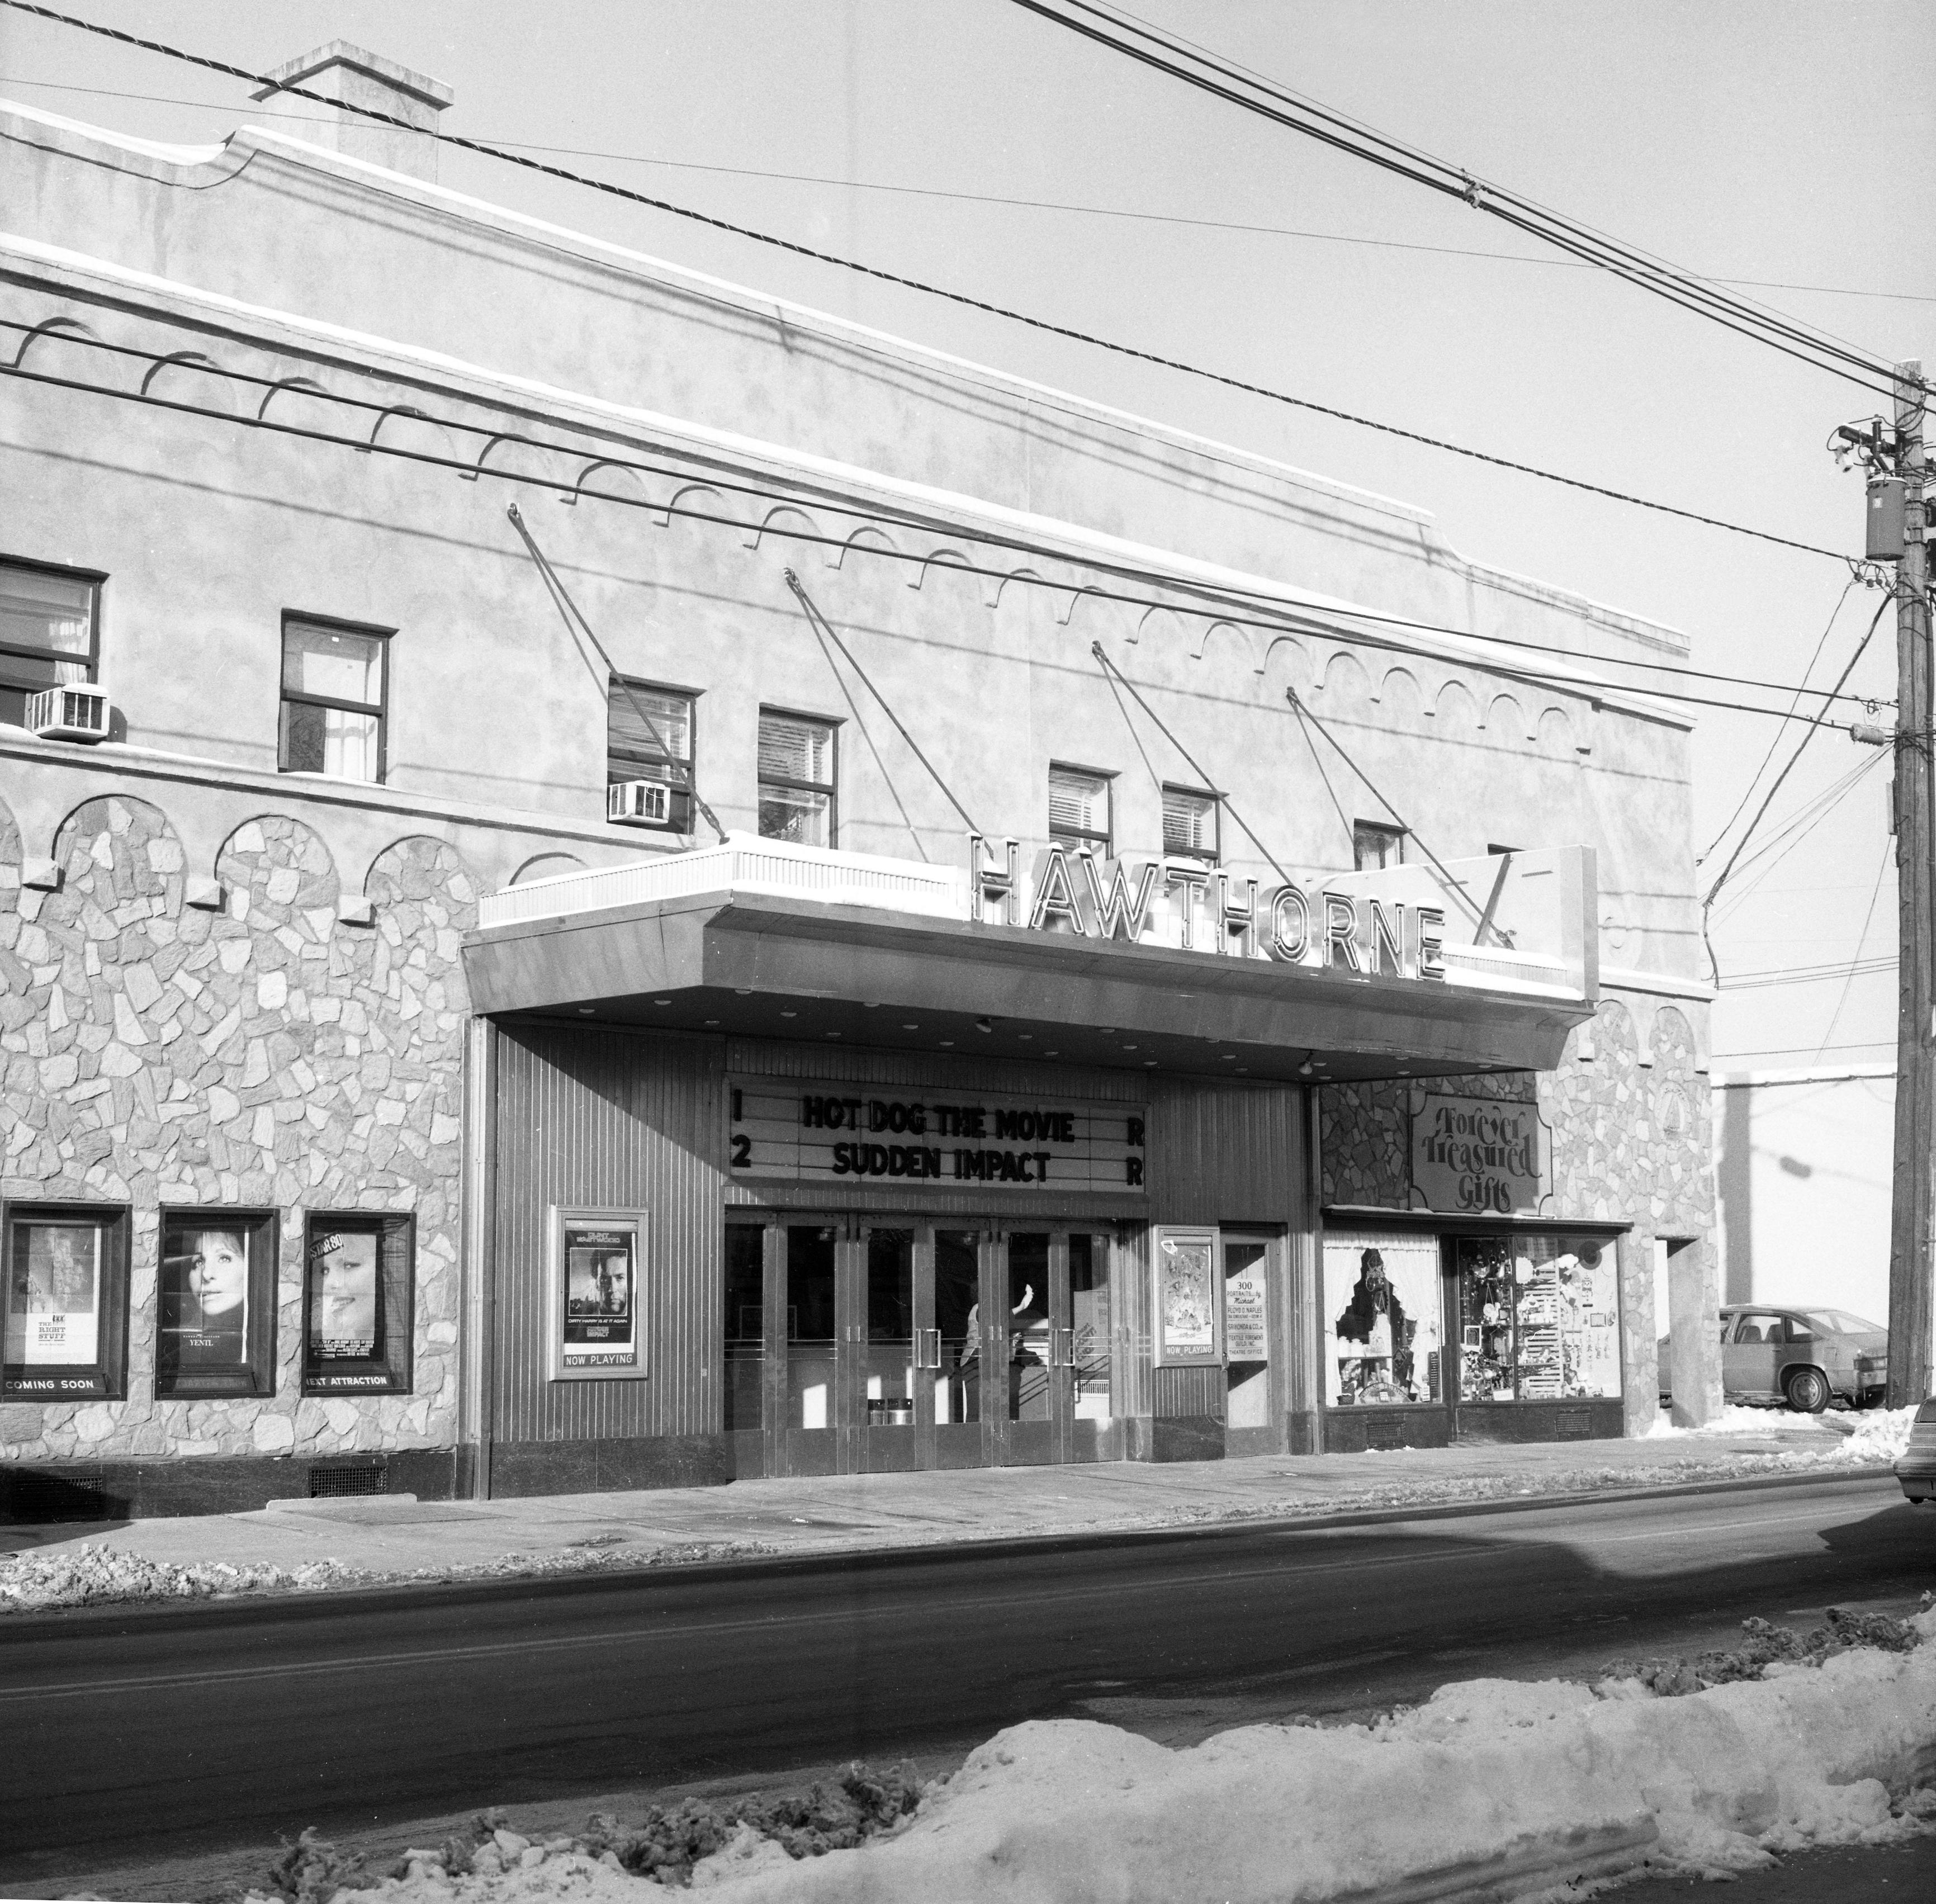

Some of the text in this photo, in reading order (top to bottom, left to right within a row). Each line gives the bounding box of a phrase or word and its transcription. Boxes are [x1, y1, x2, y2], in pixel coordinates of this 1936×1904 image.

[968, 834, 1446, 982] HAWTHORNE
[803, 1095, 862, 1130] HOT
[869, 1100, 926, 1135] DOG
[933, 1105, 986, 1138] THE
[995, 1109, 1074, 1142] MOVIE
[1127, 1117, 1144, 1146] R
[1436, 1105, 1526, 1145] Forever
[732, 1134, 1143, 1186] 2 SUDDEN IMPACT R
[1422, 1128, 1543, 1178] Treasured
[1455, 1174, 1511, 1213] Gifts
[1237, 1281, 1252, 1290] 300
[566, 1354, 632, 1365] NOW PLAYING
[6, 1380, 94, 1389] COMING SOON
[331, 1376, 387, 1385] ATTRACTION
